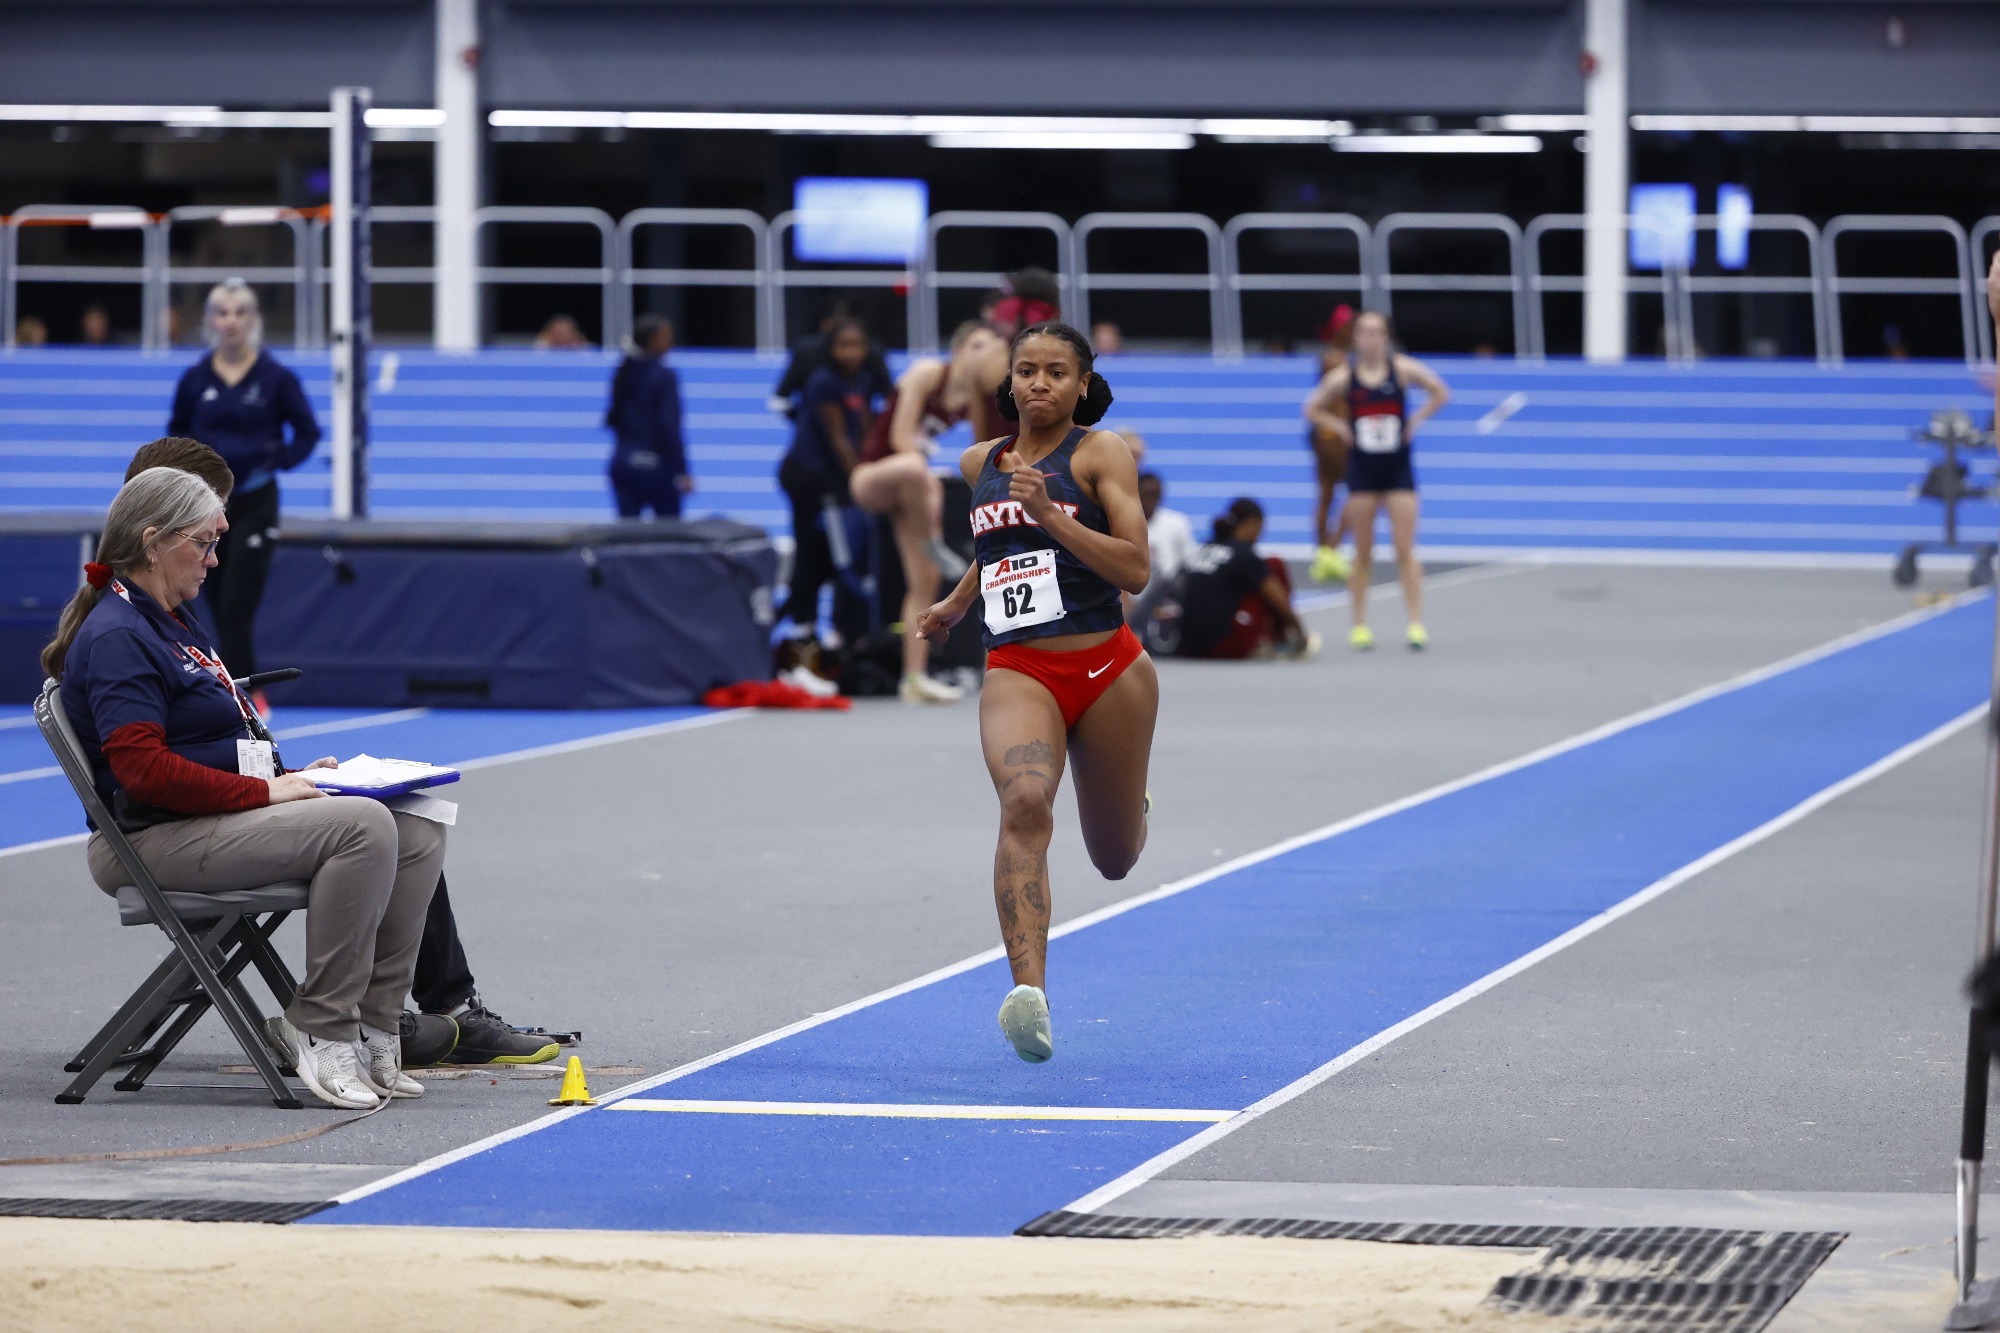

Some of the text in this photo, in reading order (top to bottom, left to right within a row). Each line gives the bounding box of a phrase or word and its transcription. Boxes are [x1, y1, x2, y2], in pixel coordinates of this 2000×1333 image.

[995, 555, 1039, 577] A10
[985, 567, 1051, 591] CHAMPIONSHIPS
[1002, 582, 1036, 619] 62
